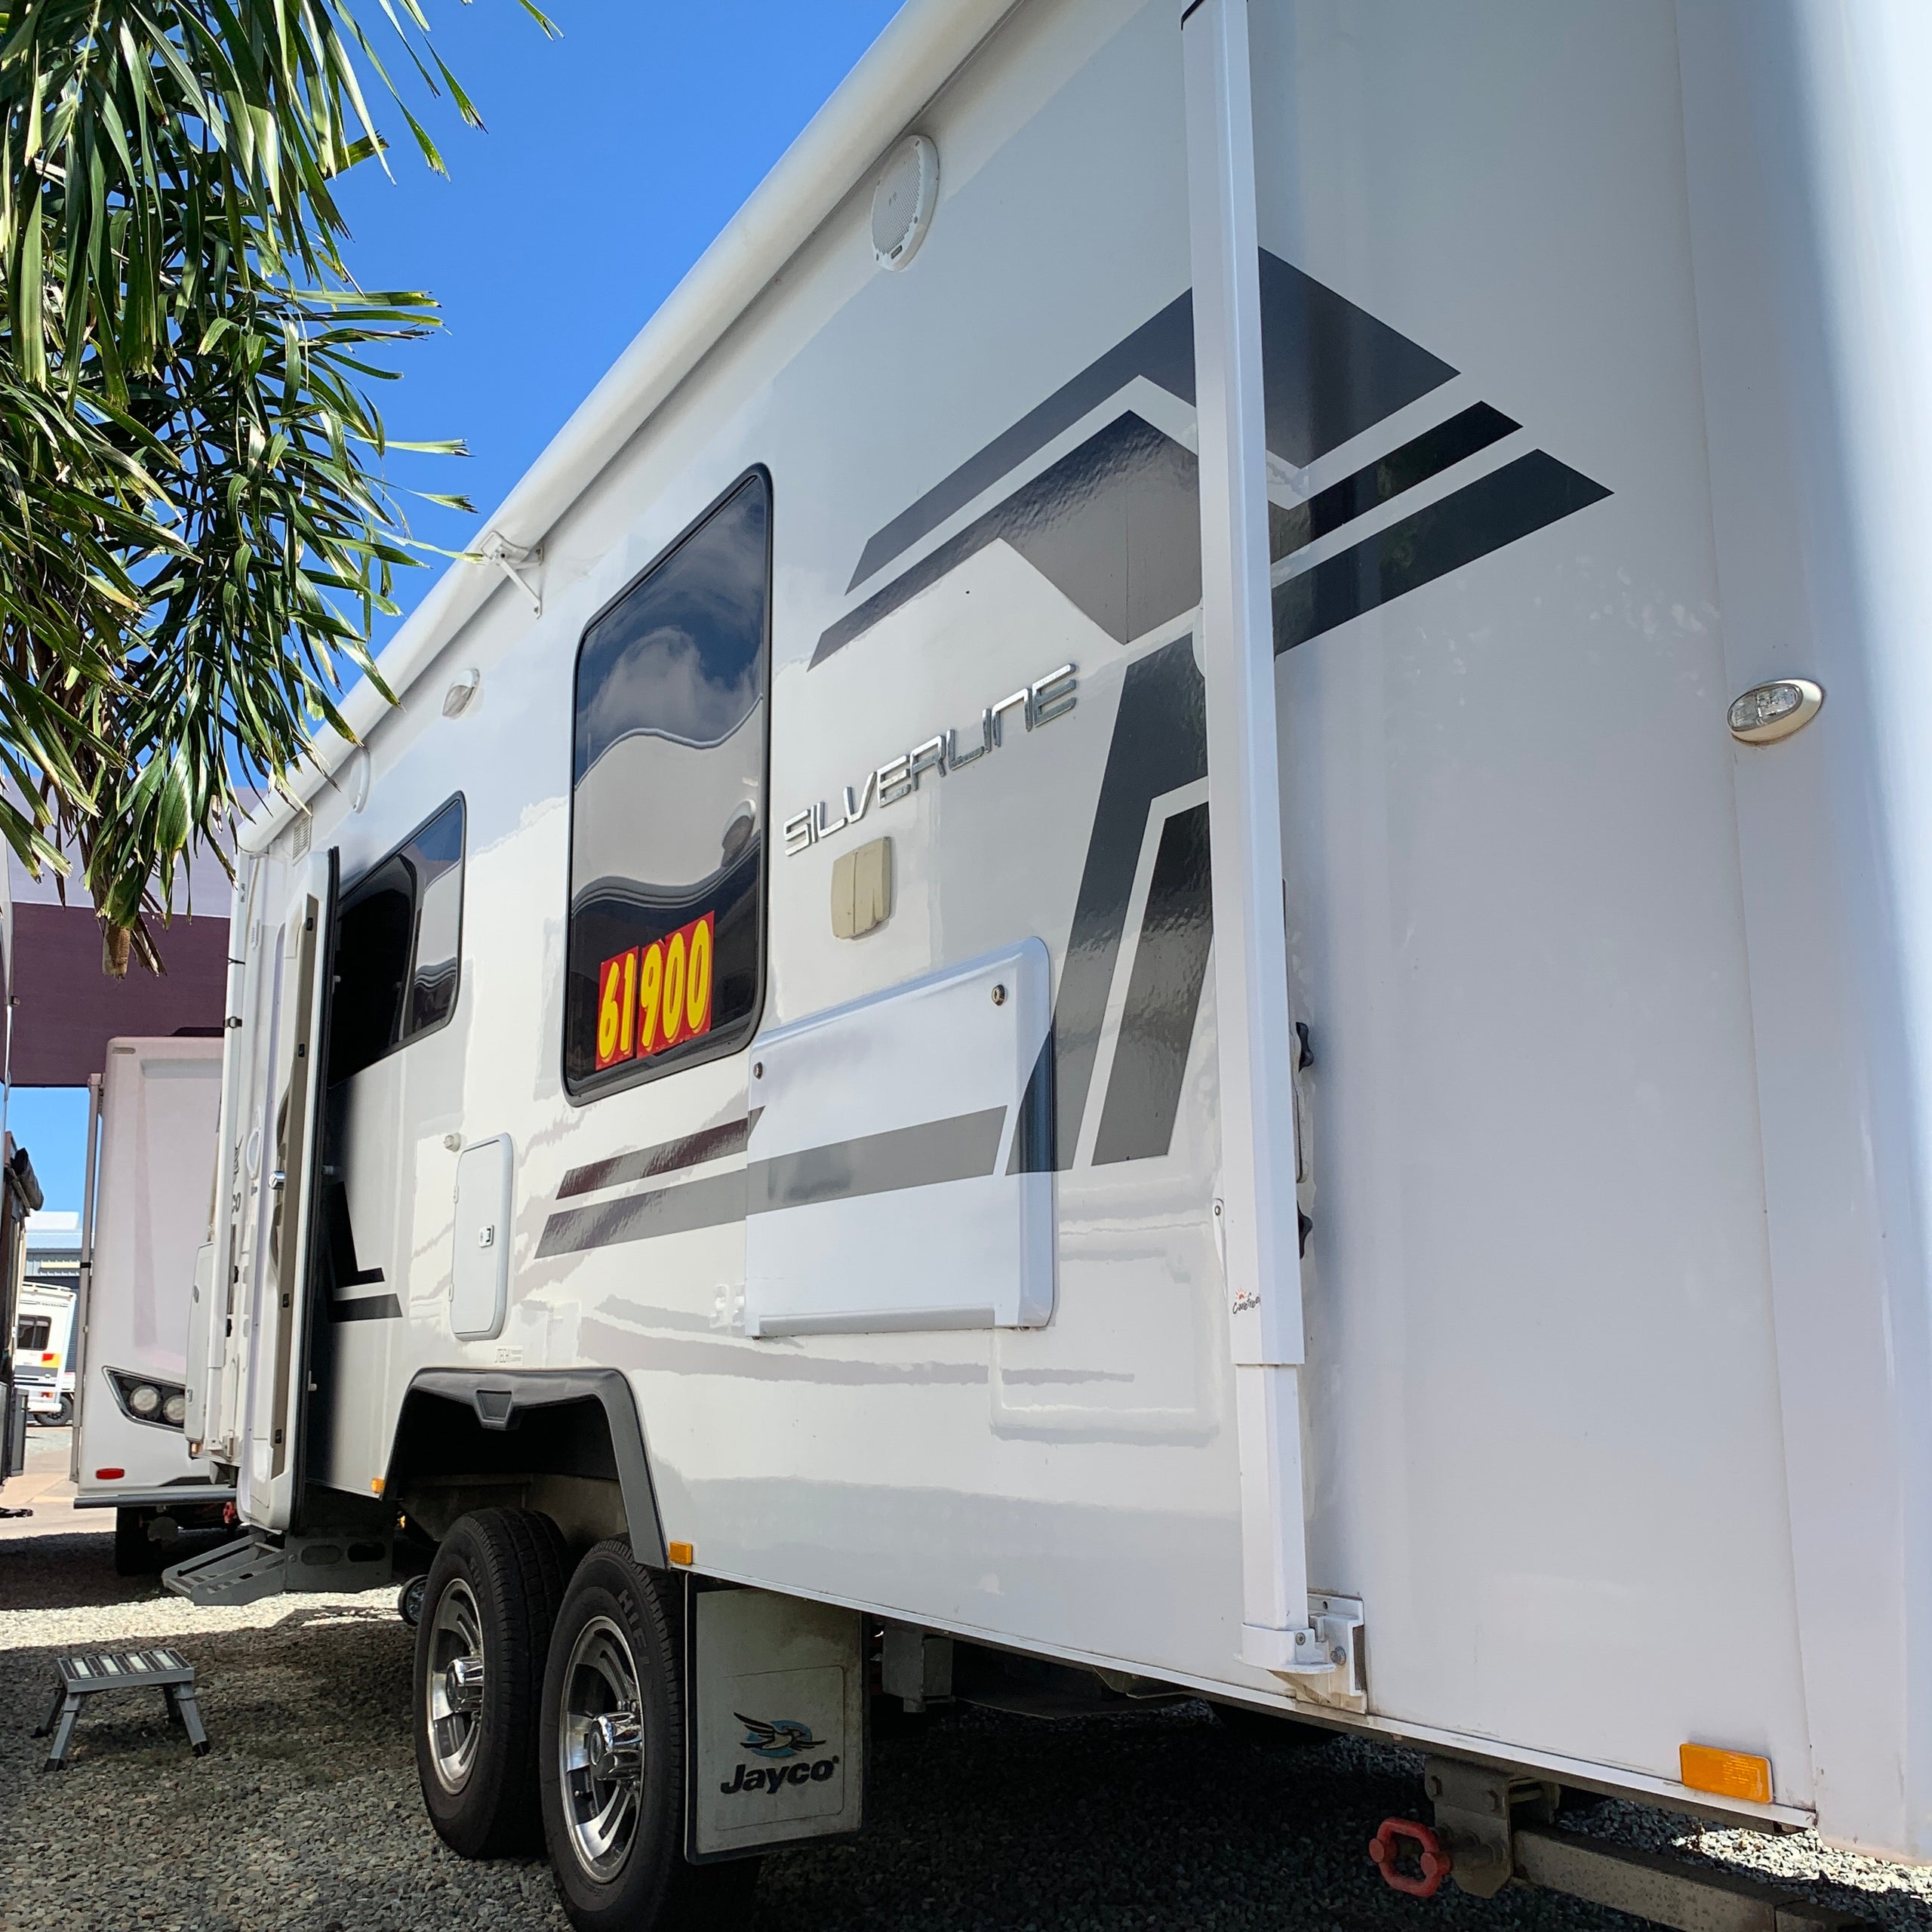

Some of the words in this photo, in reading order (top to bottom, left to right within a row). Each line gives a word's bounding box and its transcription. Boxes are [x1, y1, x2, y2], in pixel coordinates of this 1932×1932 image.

[783, 663, 1077, 857] SILVERLINE
[598, 918, 712, 1063] 61900
[720, 1759, 835, 1795] Jayco
